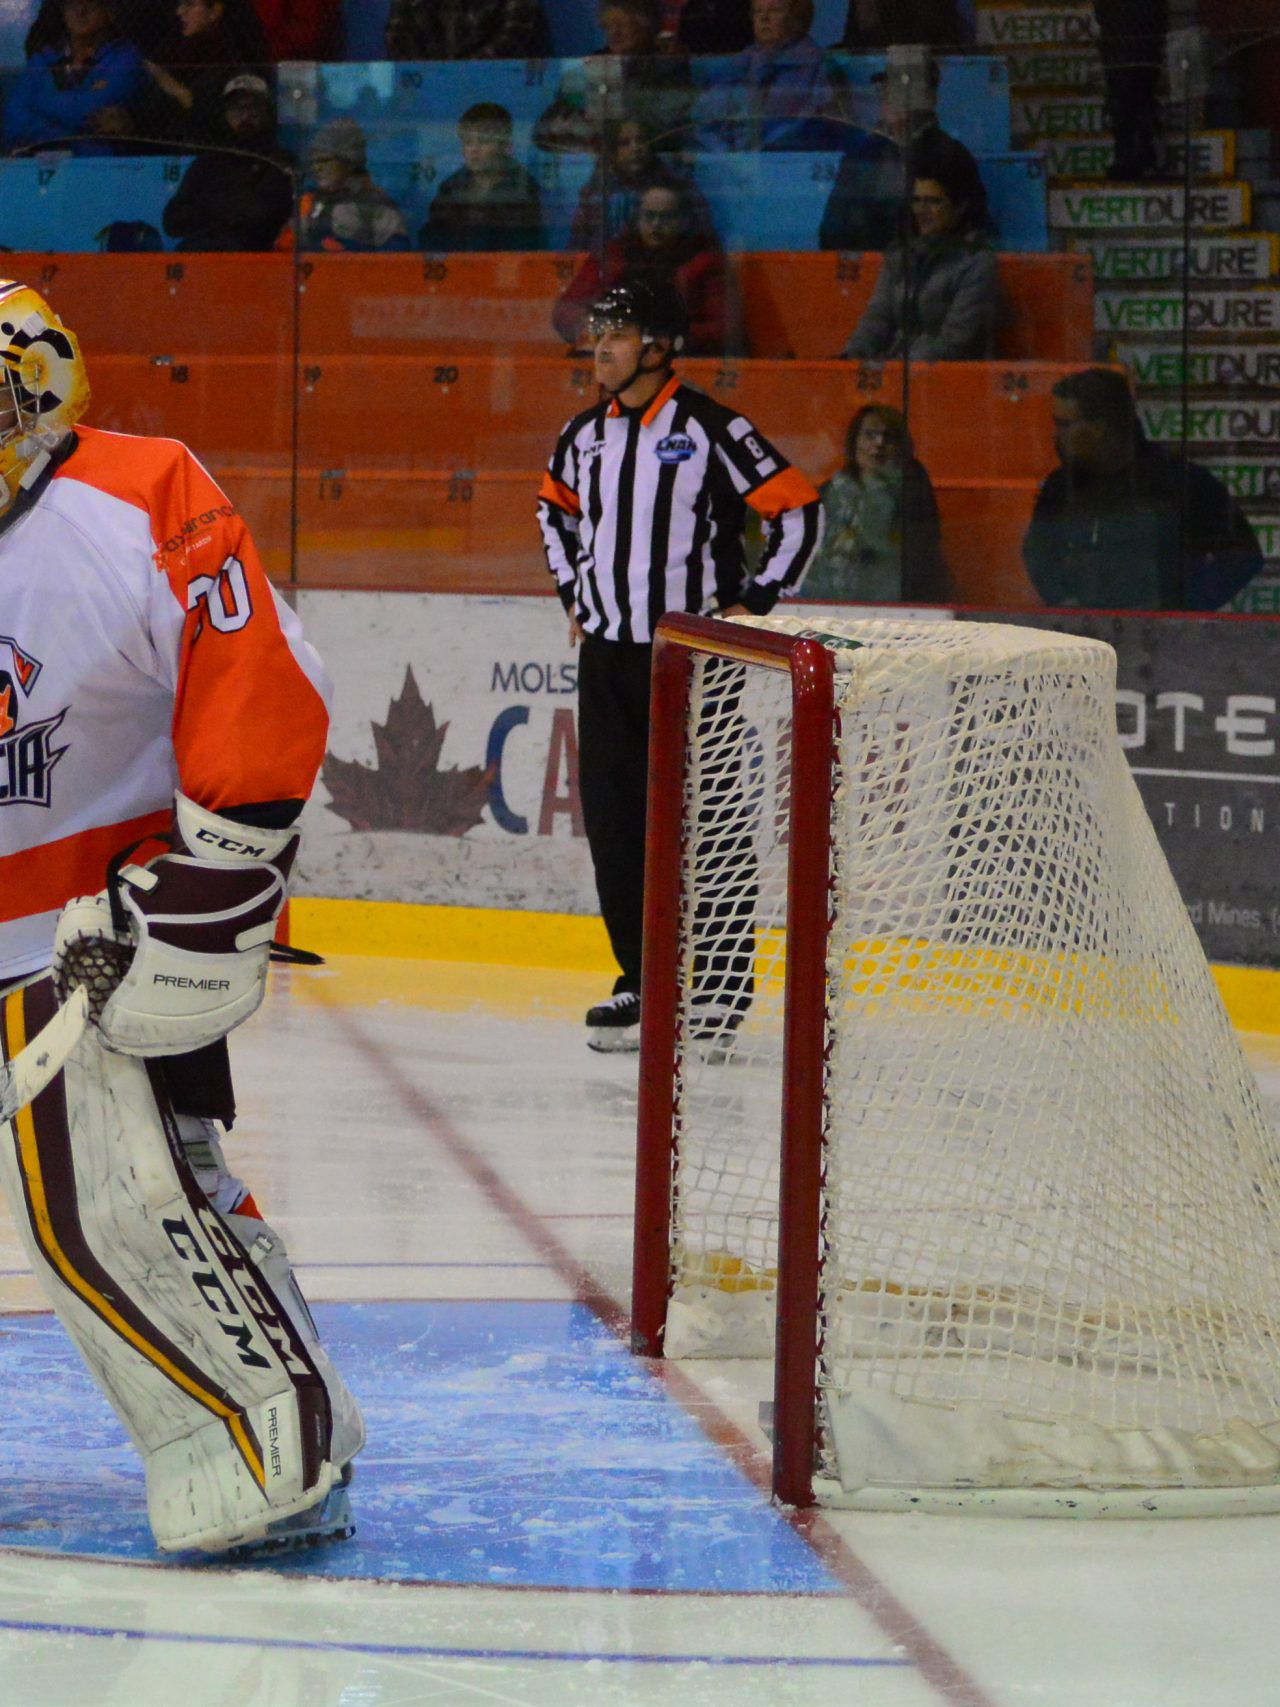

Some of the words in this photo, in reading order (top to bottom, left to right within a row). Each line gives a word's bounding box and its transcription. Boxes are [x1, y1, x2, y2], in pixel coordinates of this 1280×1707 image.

[37, 169, 55, 185] 17
[1065, 196, 1228, 223] VERTDURE
[1104, 299, 1272, 328] VERTDURE
[433, 366, 457, 383] 20
[744, 435, 764, 460] 8
[491, 661, 578, 694] MOLS
[195, 828, 268, 859] CCM
[153, 974, 230, 991] PREMIER
[161, 1214, 272, 1369] CCM
[267, 1407, 283, 1478] PREMIER
